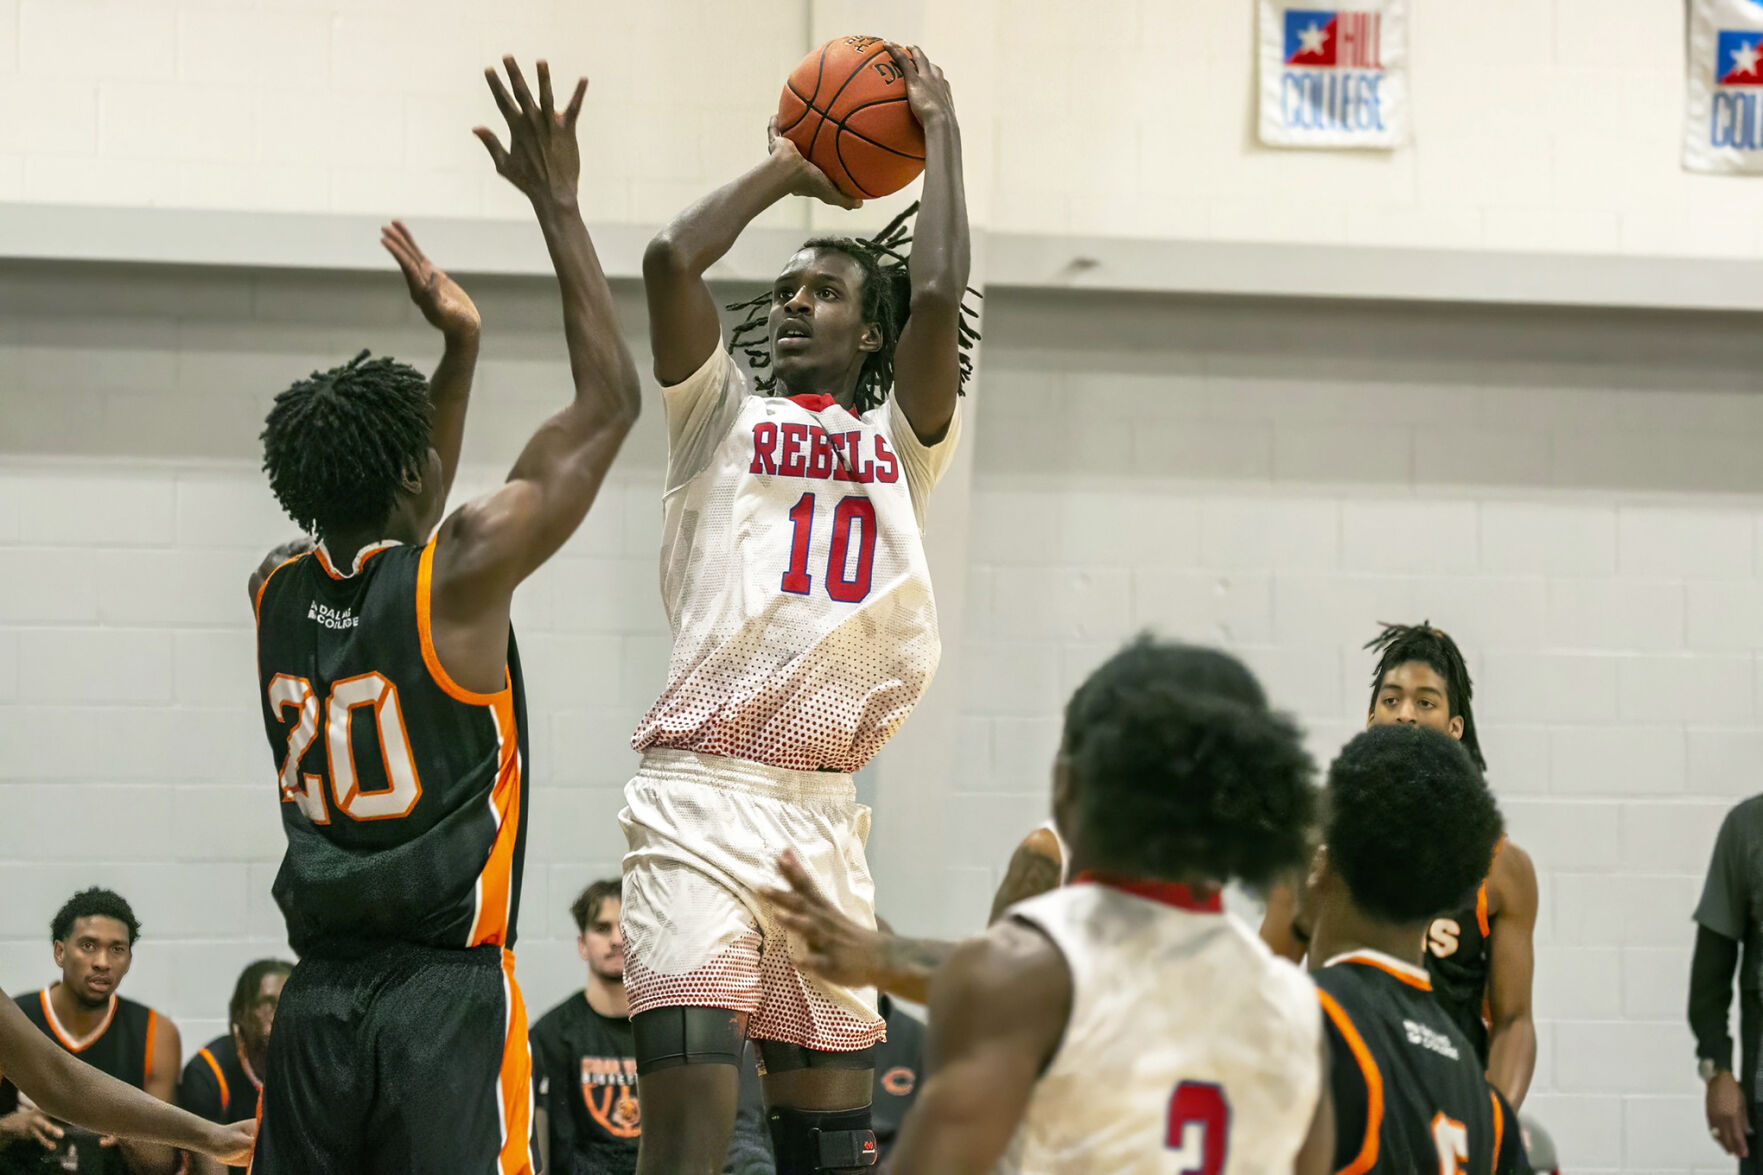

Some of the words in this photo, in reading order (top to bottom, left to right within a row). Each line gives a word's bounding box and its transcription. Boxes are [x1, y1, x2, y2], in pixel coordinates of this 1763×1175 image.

[1282, 72, 1386, 131] COLLEGE
[1711, 91, 1763, 151] COL
[749, 421, 899, 484] REBELS
[781, 492, 877, 603] 10
[267, 670, 423, 826] 20
